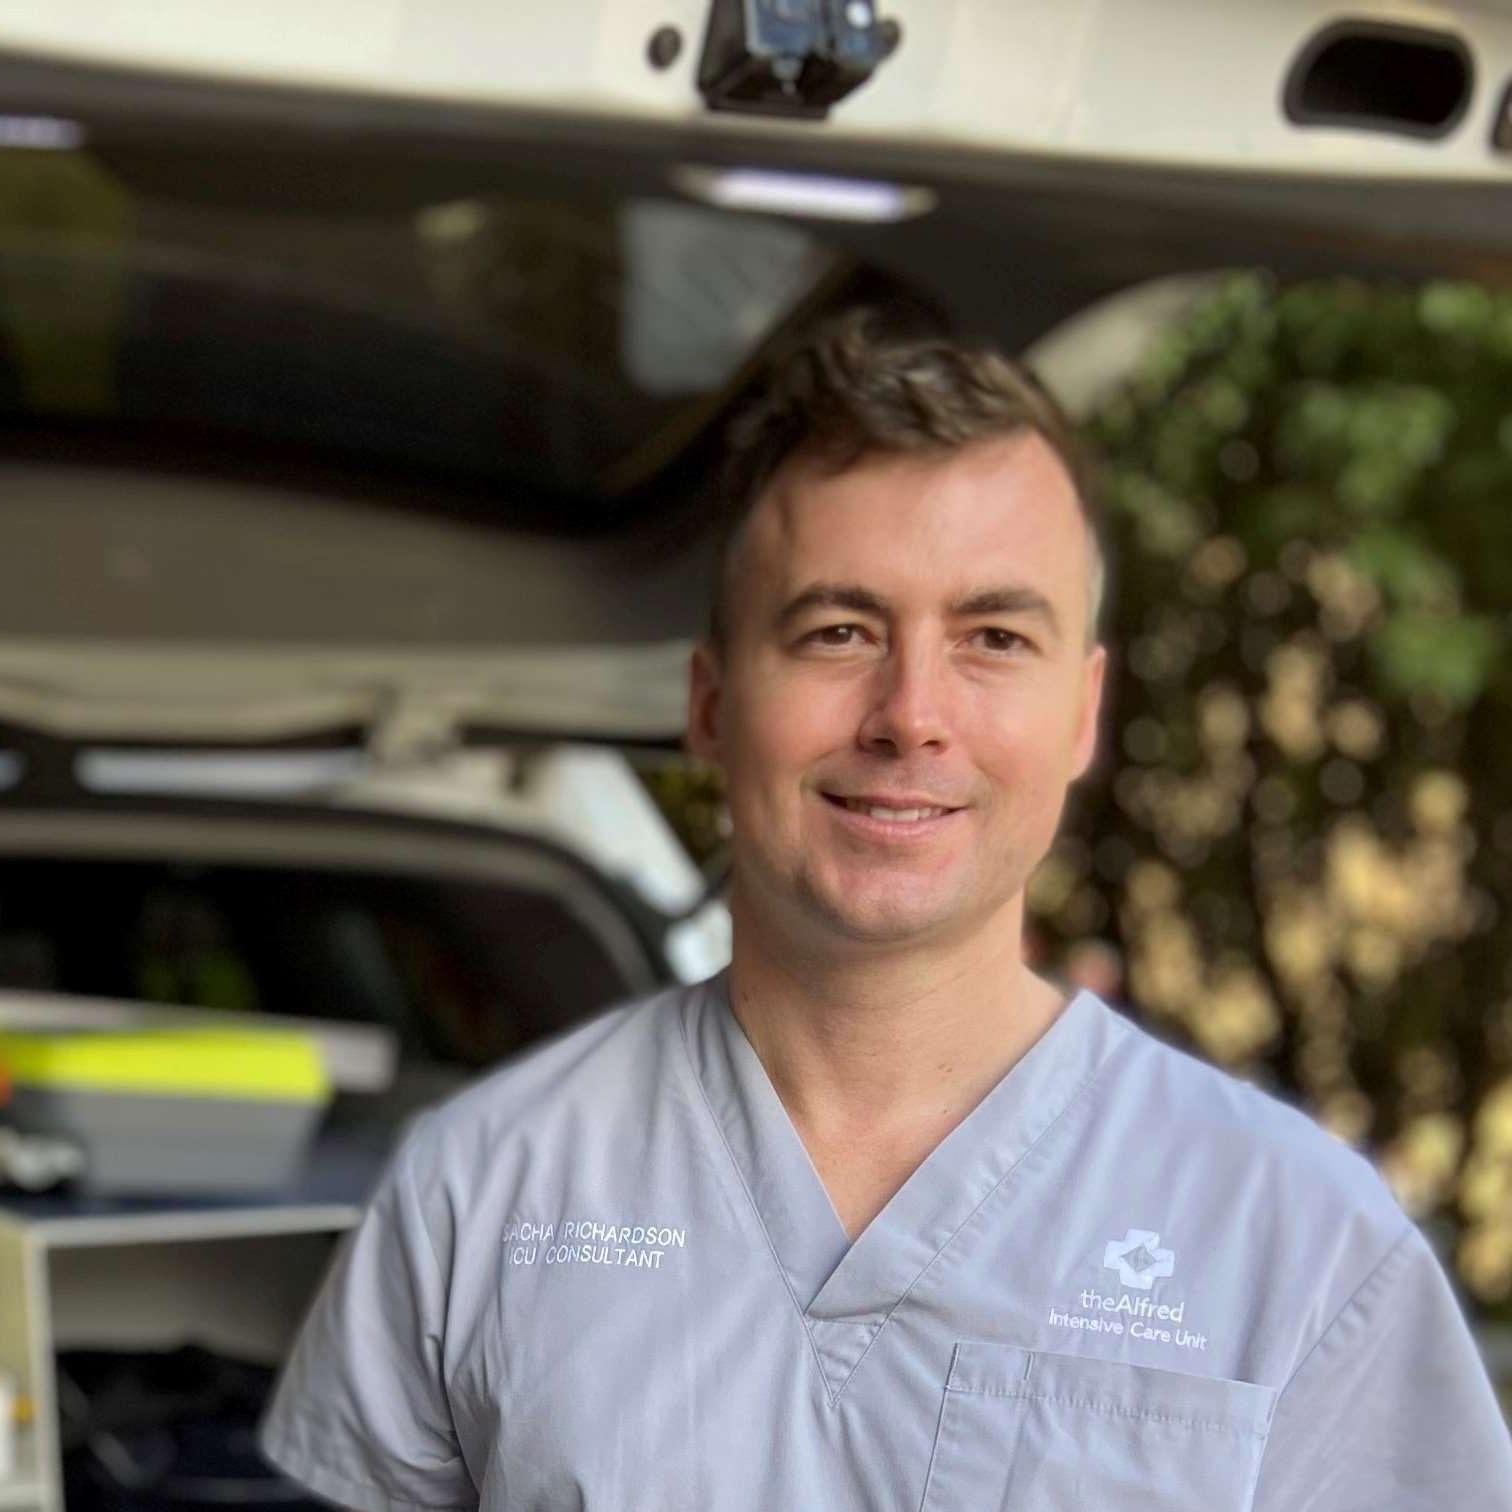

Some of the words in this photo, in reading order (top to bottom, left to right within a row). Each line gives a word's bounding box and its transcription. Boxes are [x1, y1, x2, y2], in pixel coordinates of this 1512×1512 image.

[564, 1221, 686, 1248] RICHARDSON
[509, 1246, 537, 1266] ICU
[545, 1245, 665, 1269] CONSULTANT
[1048, 1307, 1124, 1335] Intensive
[1130, 1321, 1171, 1343] Care
[1175, 1328, 1209, 1351] Unit
